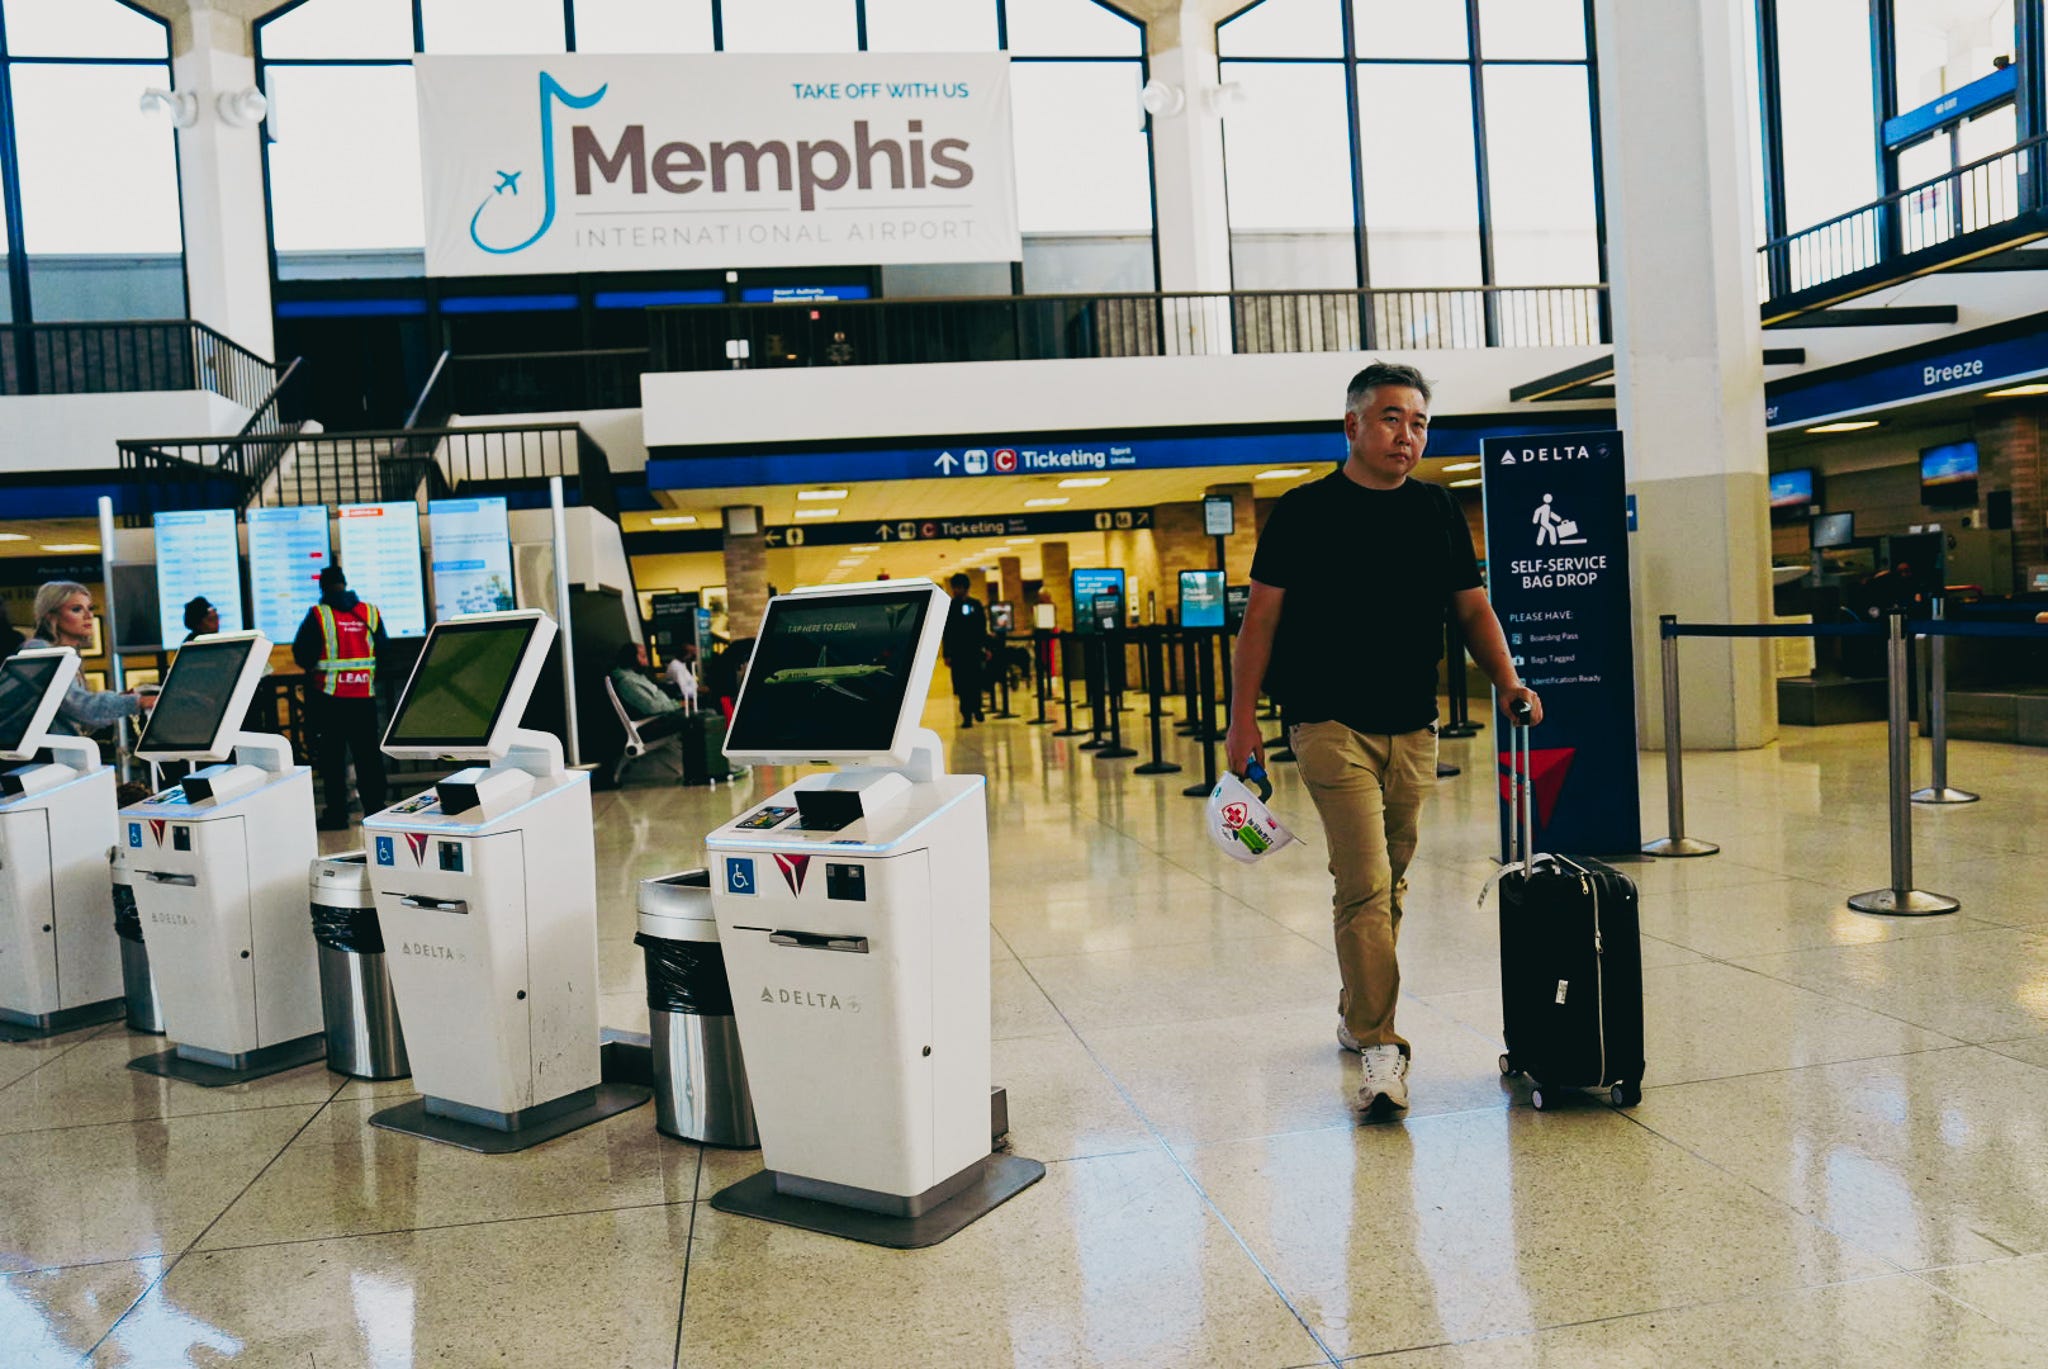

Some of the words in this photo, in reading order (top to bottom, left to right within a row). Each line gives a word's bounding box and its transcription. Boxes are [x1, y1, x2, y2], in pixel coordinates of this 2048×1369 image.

[792, 83, 840, 99] TAKE
[845, 83, 881, 98] OFF
[887, 83, 938, 98] WITH
[943, 82, 969, 98] US
[572, 120, 974, 211] Memphis
[576, 222, 831, 248] INTERNATIONAL
[848, 220, 976, 241] AIRPORT
[1923, 359, 1983, 385] Breeze
[997, 451, 1013, 469] C
[1022, 449, 1106, 469] Ticketing
[1522, 446, 1589, 462] DELTA
[942, 521, 1005, 535] Ticketing
[1511, 556, 1607, 574] SELF-SERVICE
[1522, 574, 1553, 589] BAG
[1556, 572, 1598, 588] DROP
[1509, 612, 1543, 622] PLEASE
[802, 624, 821, 632] HERE
[823, 623, 833, 631] TO
[833, 622, 857, 631] BEGIN
[1530, 633, 1561, 642] Boarding
[1562, 632, 1579, 640] Pass
[1531, 656, 1548, 664] Bags
[1549, 654, 1576, 663] Tagged
[338, 673, 369, 683] LEAD
[1532, 676, 1578, 685] Identification
[1579, 674, 1602, 683] Ready
[414, 944, 454, 960] DELTA
[779, 988, 841, 1010] DELTA
